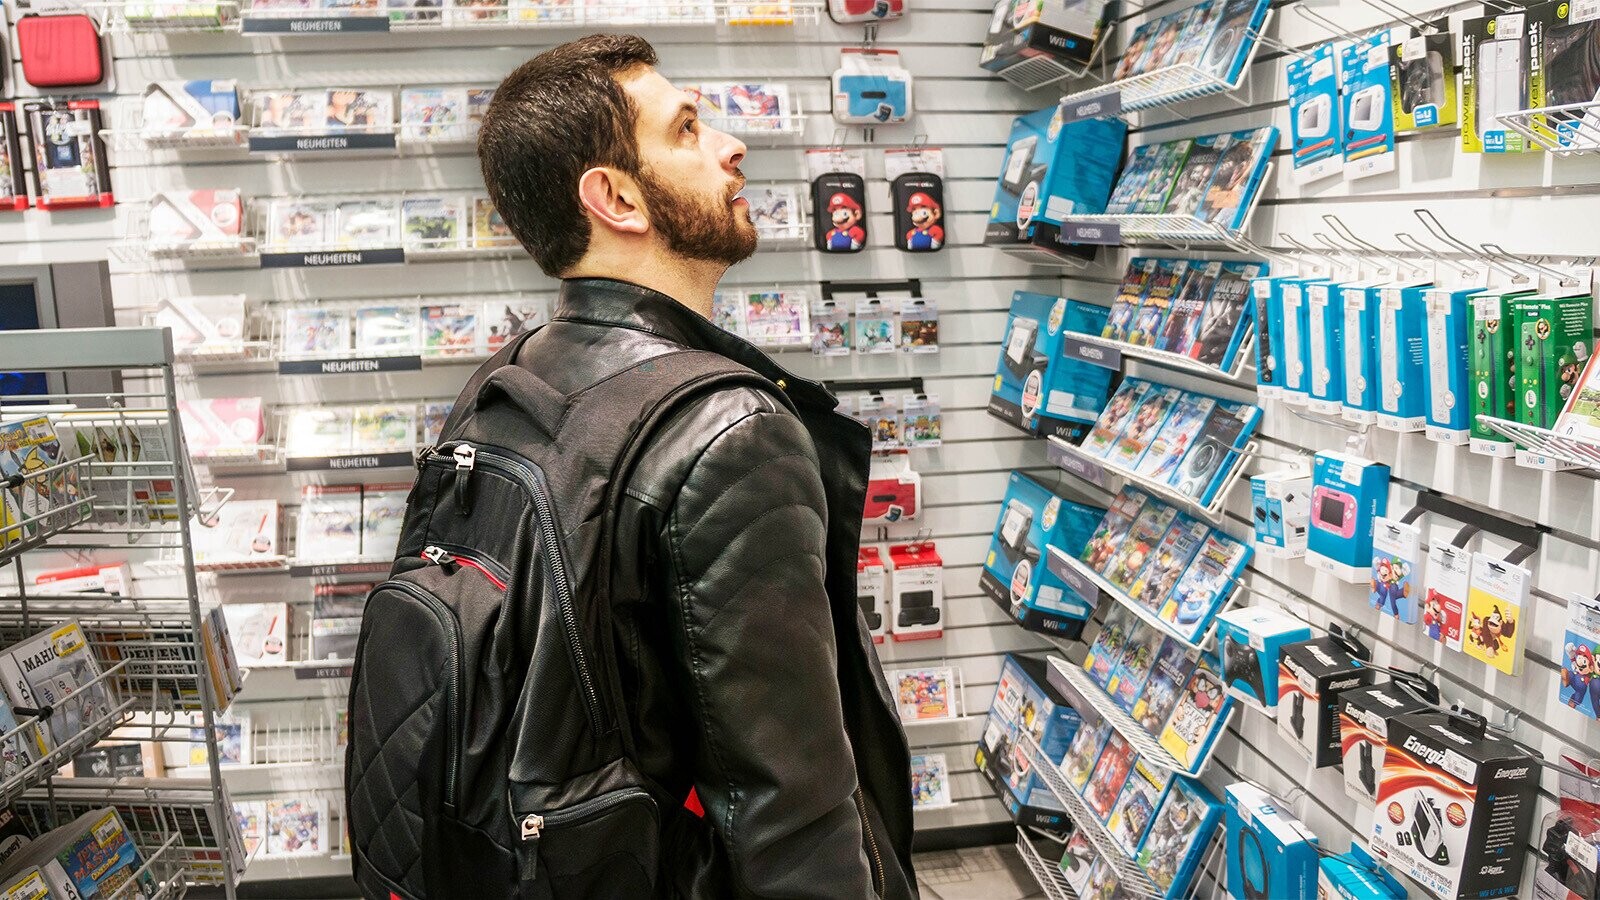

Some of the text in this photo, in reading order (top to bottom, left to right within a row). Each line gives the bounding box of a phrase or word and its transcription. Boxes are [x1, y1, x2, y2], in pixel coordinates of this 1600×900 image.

[290, 20, 342, 31] NEUHEITEN
[296, 137, 348, 149] NEUHEITEN
[304, 253, 362, 265] NEUHEITEN
[322, 360, 379, 372] NEUHEITEN
[330, 456, 379, 469] NEUHEITEN
[312, 567, 336, 575] JETZT
[1329, 678, 1361, 689] Energizer
[1494, 767, 1529, 779] Energizer
